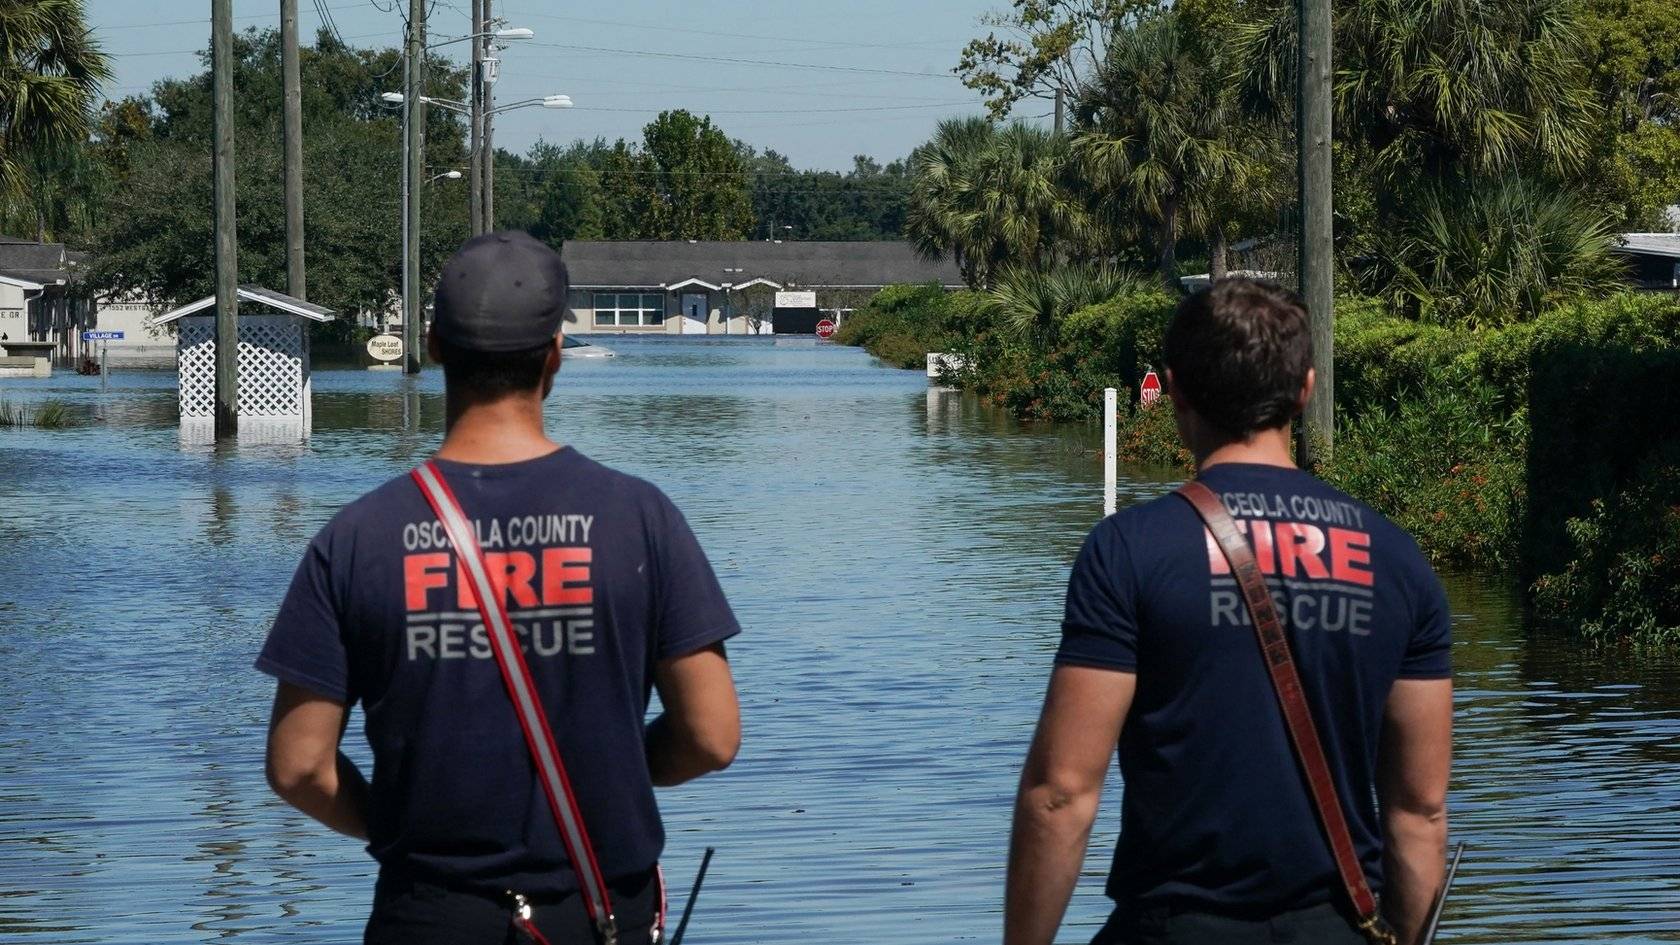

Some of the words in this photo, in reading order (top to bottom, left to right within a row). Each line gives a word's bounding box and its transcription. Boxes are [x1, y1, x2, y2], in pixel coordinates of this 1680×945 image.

[816, 325, 834, 333] STOP
[1216, 492, 1291, 519] CEOLA
[1291, 495, 1364, 529] COUNTY
[403, 518, 504, 551] OSCLA
[507, 514, 594, 547] COUNTY
[1210, 590, 1374, 636] RSCUE
